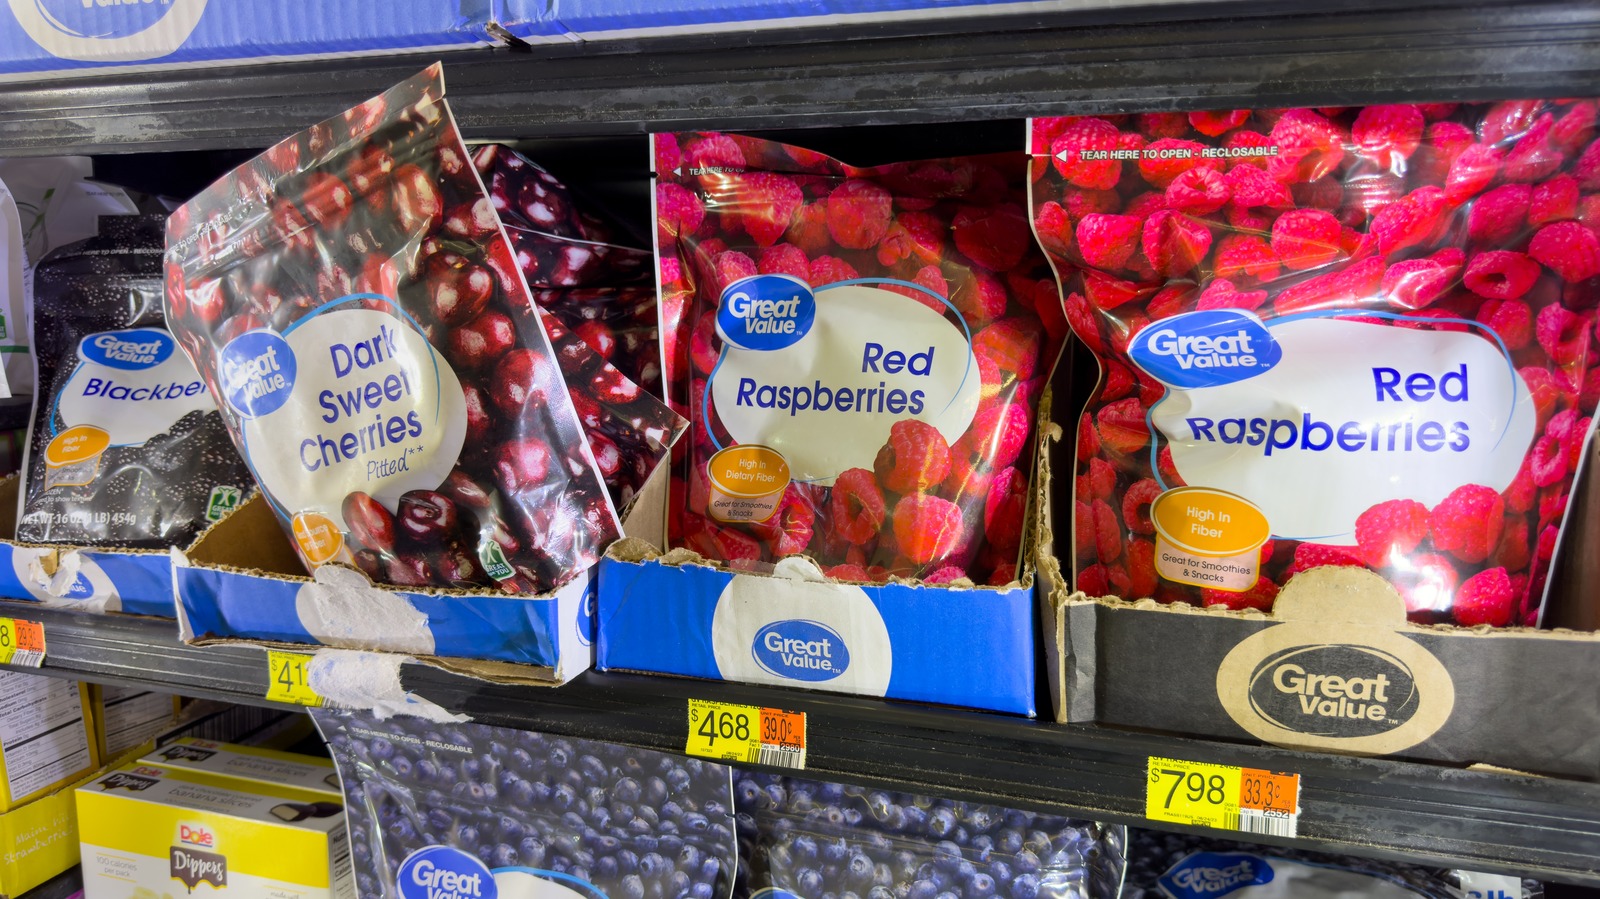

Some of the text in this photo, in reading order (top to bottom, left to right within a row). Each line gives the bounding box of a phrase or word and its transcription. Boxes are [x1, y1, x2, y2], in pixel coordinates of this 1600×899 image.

[1081, 151, 1107, 160] TEAR
[1110, 150, 1139, 159] HERE
[1142, 150, 1158, 159] TO
[1160, 149, 1191, 159] OPEN
[1202, 146, 1278, 158] RECLOSABLE
[728, 291, 800, 319] Great
[745, 317, 796, 334] Value
[94, 335, 162, 364] Great Value
[330, 324, 398, 379] Dark
[1147, 329, 1254, 356] Great
[861, 342, 935, 376] Red
[1174, 353, 1257, 370] Value
[224, 345, 285, 402] Great Value
[1371, 363, 1469, 402] Red
[318, 370, 412, 424] Sweet
[736, 377, 925, 416] Raspberries
[299, 409, 423, 472] Cherries
[1186, 412, 1471, 456] Raspberries
[725, 470, 775, 483] Dietary Fiber
[739, 458, 766, 470] High In
[56, 513, 67, 524] 16
[95, 512, 110, 525] LB)
[111, 513, 137, 526] 454g
[740, 502, 773, 510] Smoothies
[1186, 506, 1231, 523] High In
[1191, 523, 1223, 538] Fiber
[496, 567, 510, 576] YOU
[1162, 553, 1251, 575] Great for Smoothies
[1183, 569, 1224, 583] & Snacks
[764, 631, 832, 658] Great
[781, 652, 832, 671] Value
[1272, 663, 1390, 703] Great
[1299, 694, 1386, 721] Value
[351, 727, 370, 736] TEAR
[370, 730, 389, 739] HERE
[390, 733, 400, 741] TO
[401, 735, 421, 744] OPEN
[426, 740, 473, 754] RECLOSABLE
[780, 742, 800, 752] 2980
[1263, 807, 1289, 818] 2552
[181, 825, 213, 845] Dole
[174, 850, 223, 882] Dippers
[412, 859, 482, 897] Great
[1171, 860, 1254, 893] Great Value
